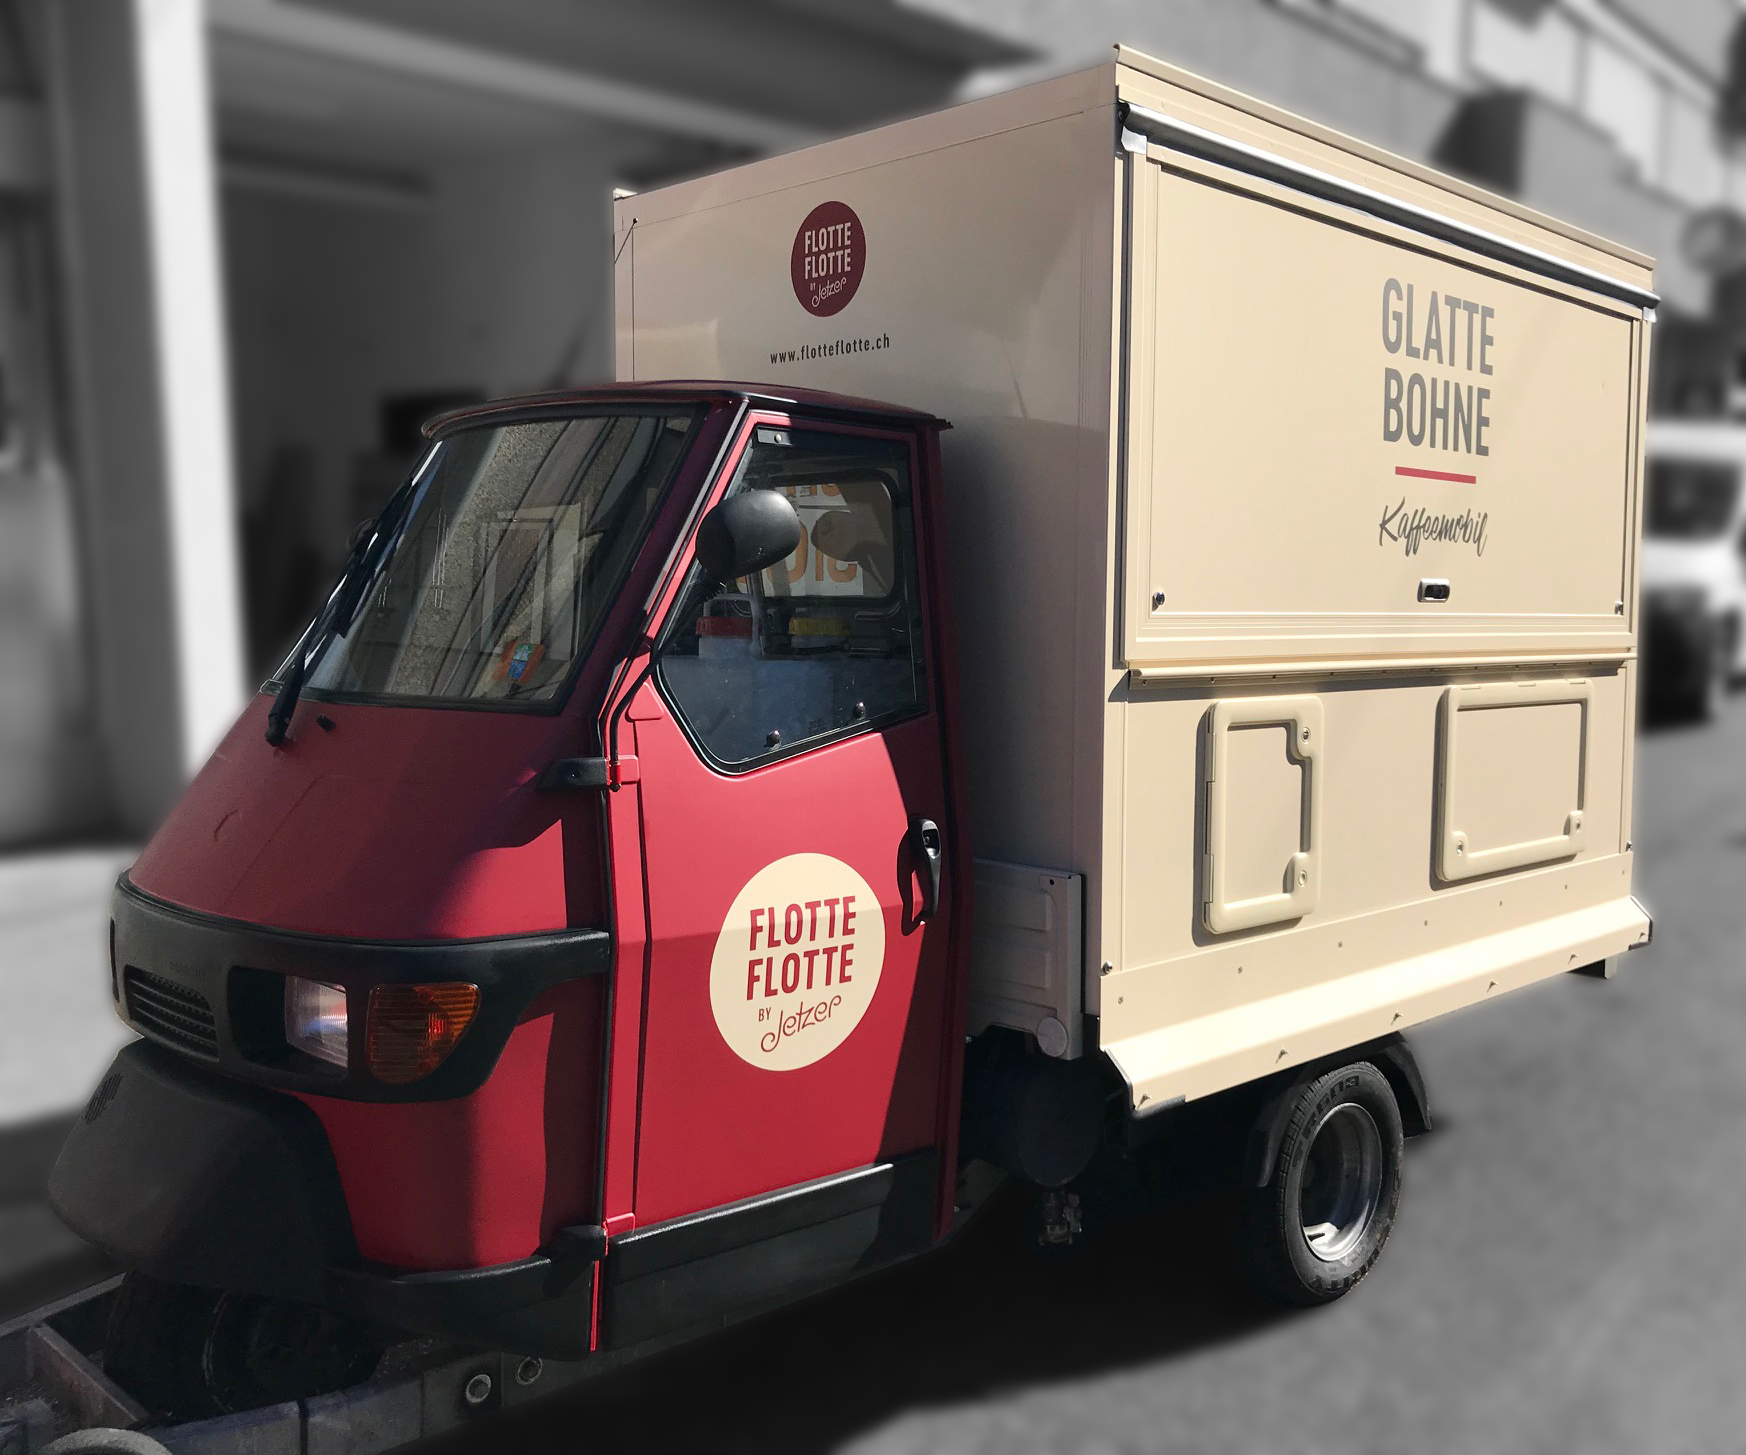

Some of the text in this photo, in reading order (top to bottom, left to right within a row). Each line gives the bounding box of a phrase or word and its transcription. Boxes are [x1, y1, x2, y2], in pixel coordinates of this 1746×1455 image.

[805, 222, 851, 254] FLOTTE
[805, 249, 851, 280] FLOTTE
[809, 277, 847, 307] BY Jetzer
[770, 333, 890, 364] www.flotteflotte.ch
[1382, 278, 1494, 376] GLATTE
[1383, 367, 1490, 456] BOHNE
[1378, 496, 1488, 557] Kaffeemobil
[749, 895, 856, 951] FLOTTE
[746, 943, 854, 1001] FLOTTE
[758, 995, 842, 1052] BY Jetzer
